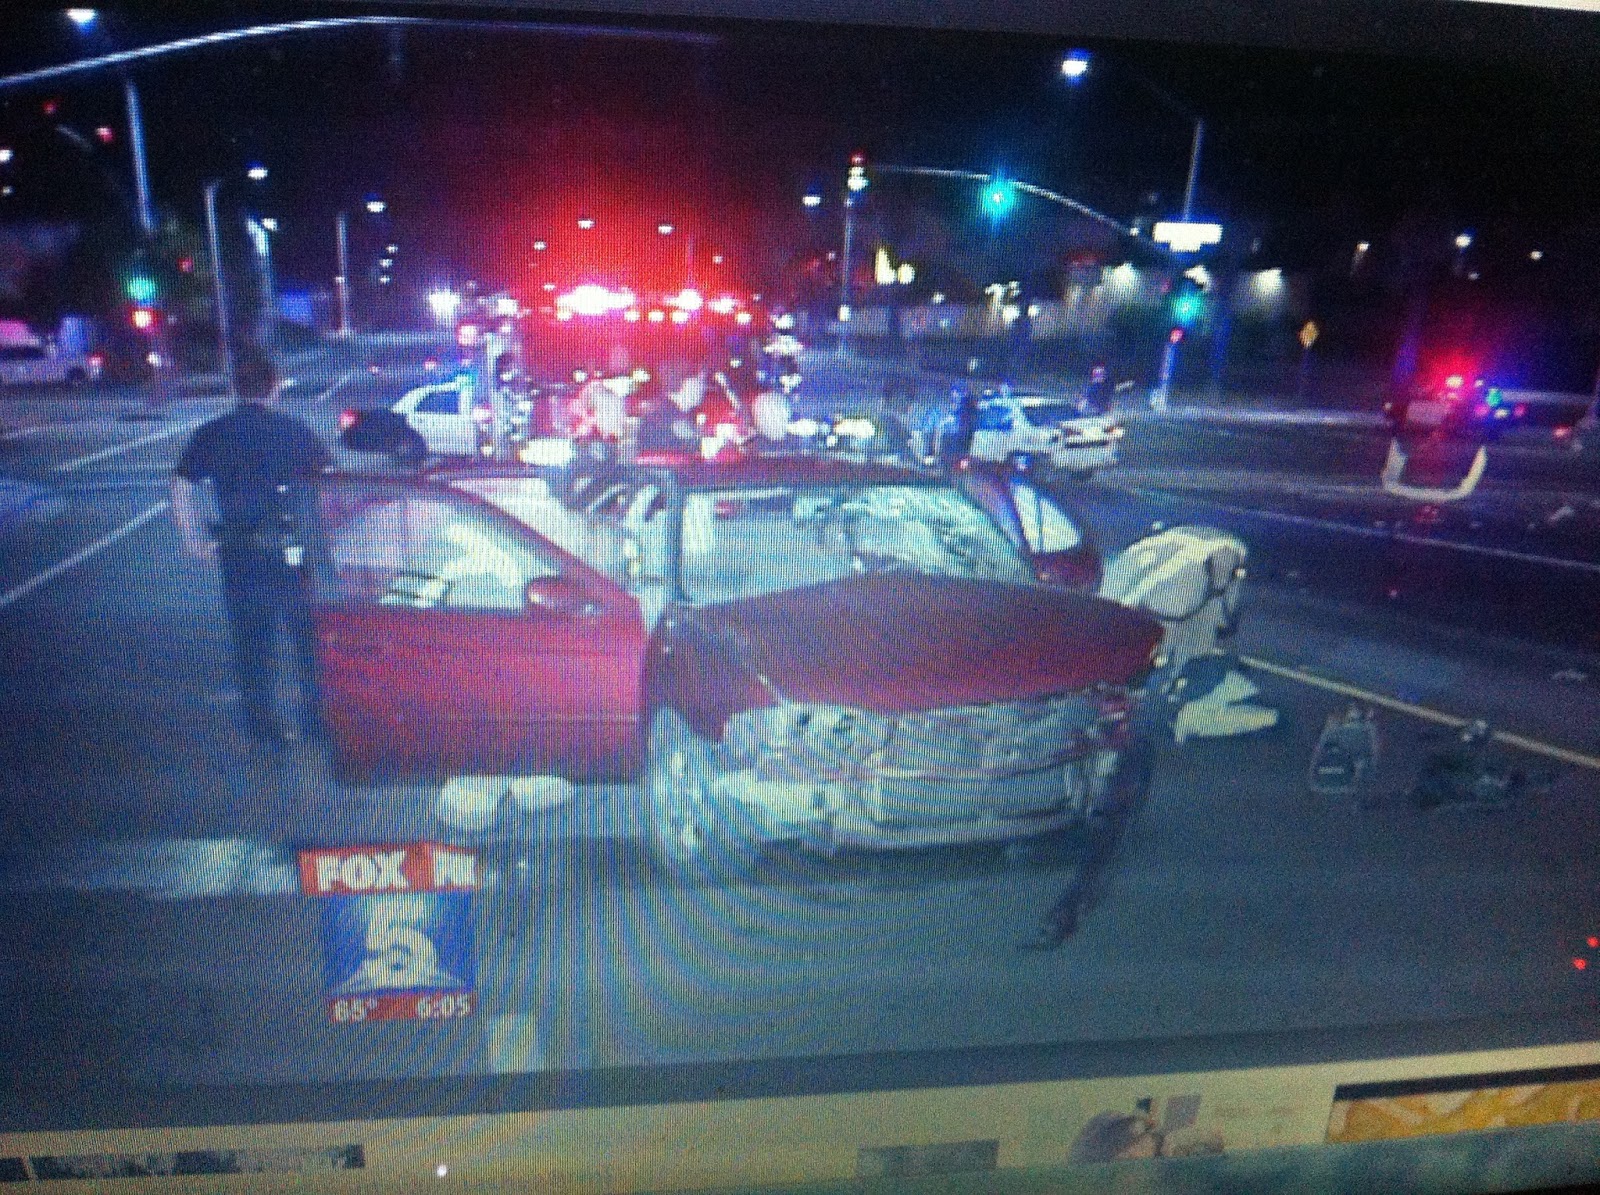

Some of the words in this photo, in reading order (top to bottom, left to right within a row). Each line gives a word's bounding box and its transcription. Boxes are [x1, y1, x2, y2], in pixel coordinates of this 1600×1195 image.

[316, 850, 409, 891] FOX
[366, 897, 437, 987] 5
[417, 994, 471, 1019] 6:05
